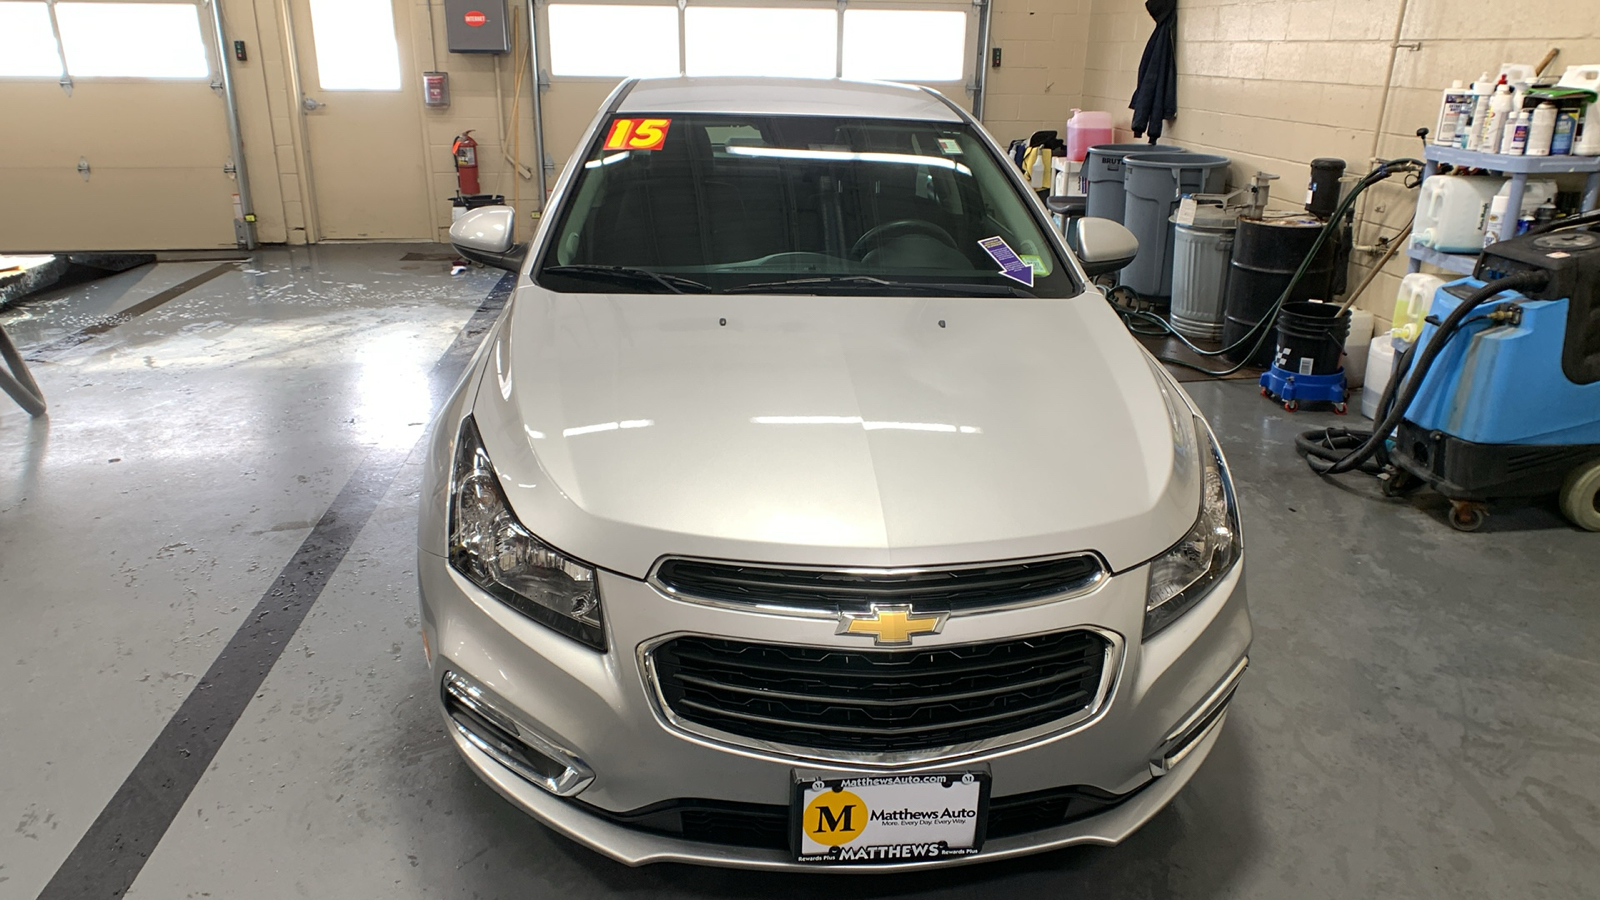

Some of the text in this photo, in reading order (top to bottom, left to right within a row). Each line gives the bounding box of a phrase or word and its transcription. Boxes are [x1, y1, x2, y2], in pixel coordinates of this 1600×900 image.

[607, 119, 669, 148] 15
[841, 775, 947, 788] MatthewsAuto.com
[813, 804, 857, 833] M
[870, 807, 976, 821] Matthews Auto
[933, 818, 952, 826] Every
[839, 843, 939, 861] MATTHEWS
